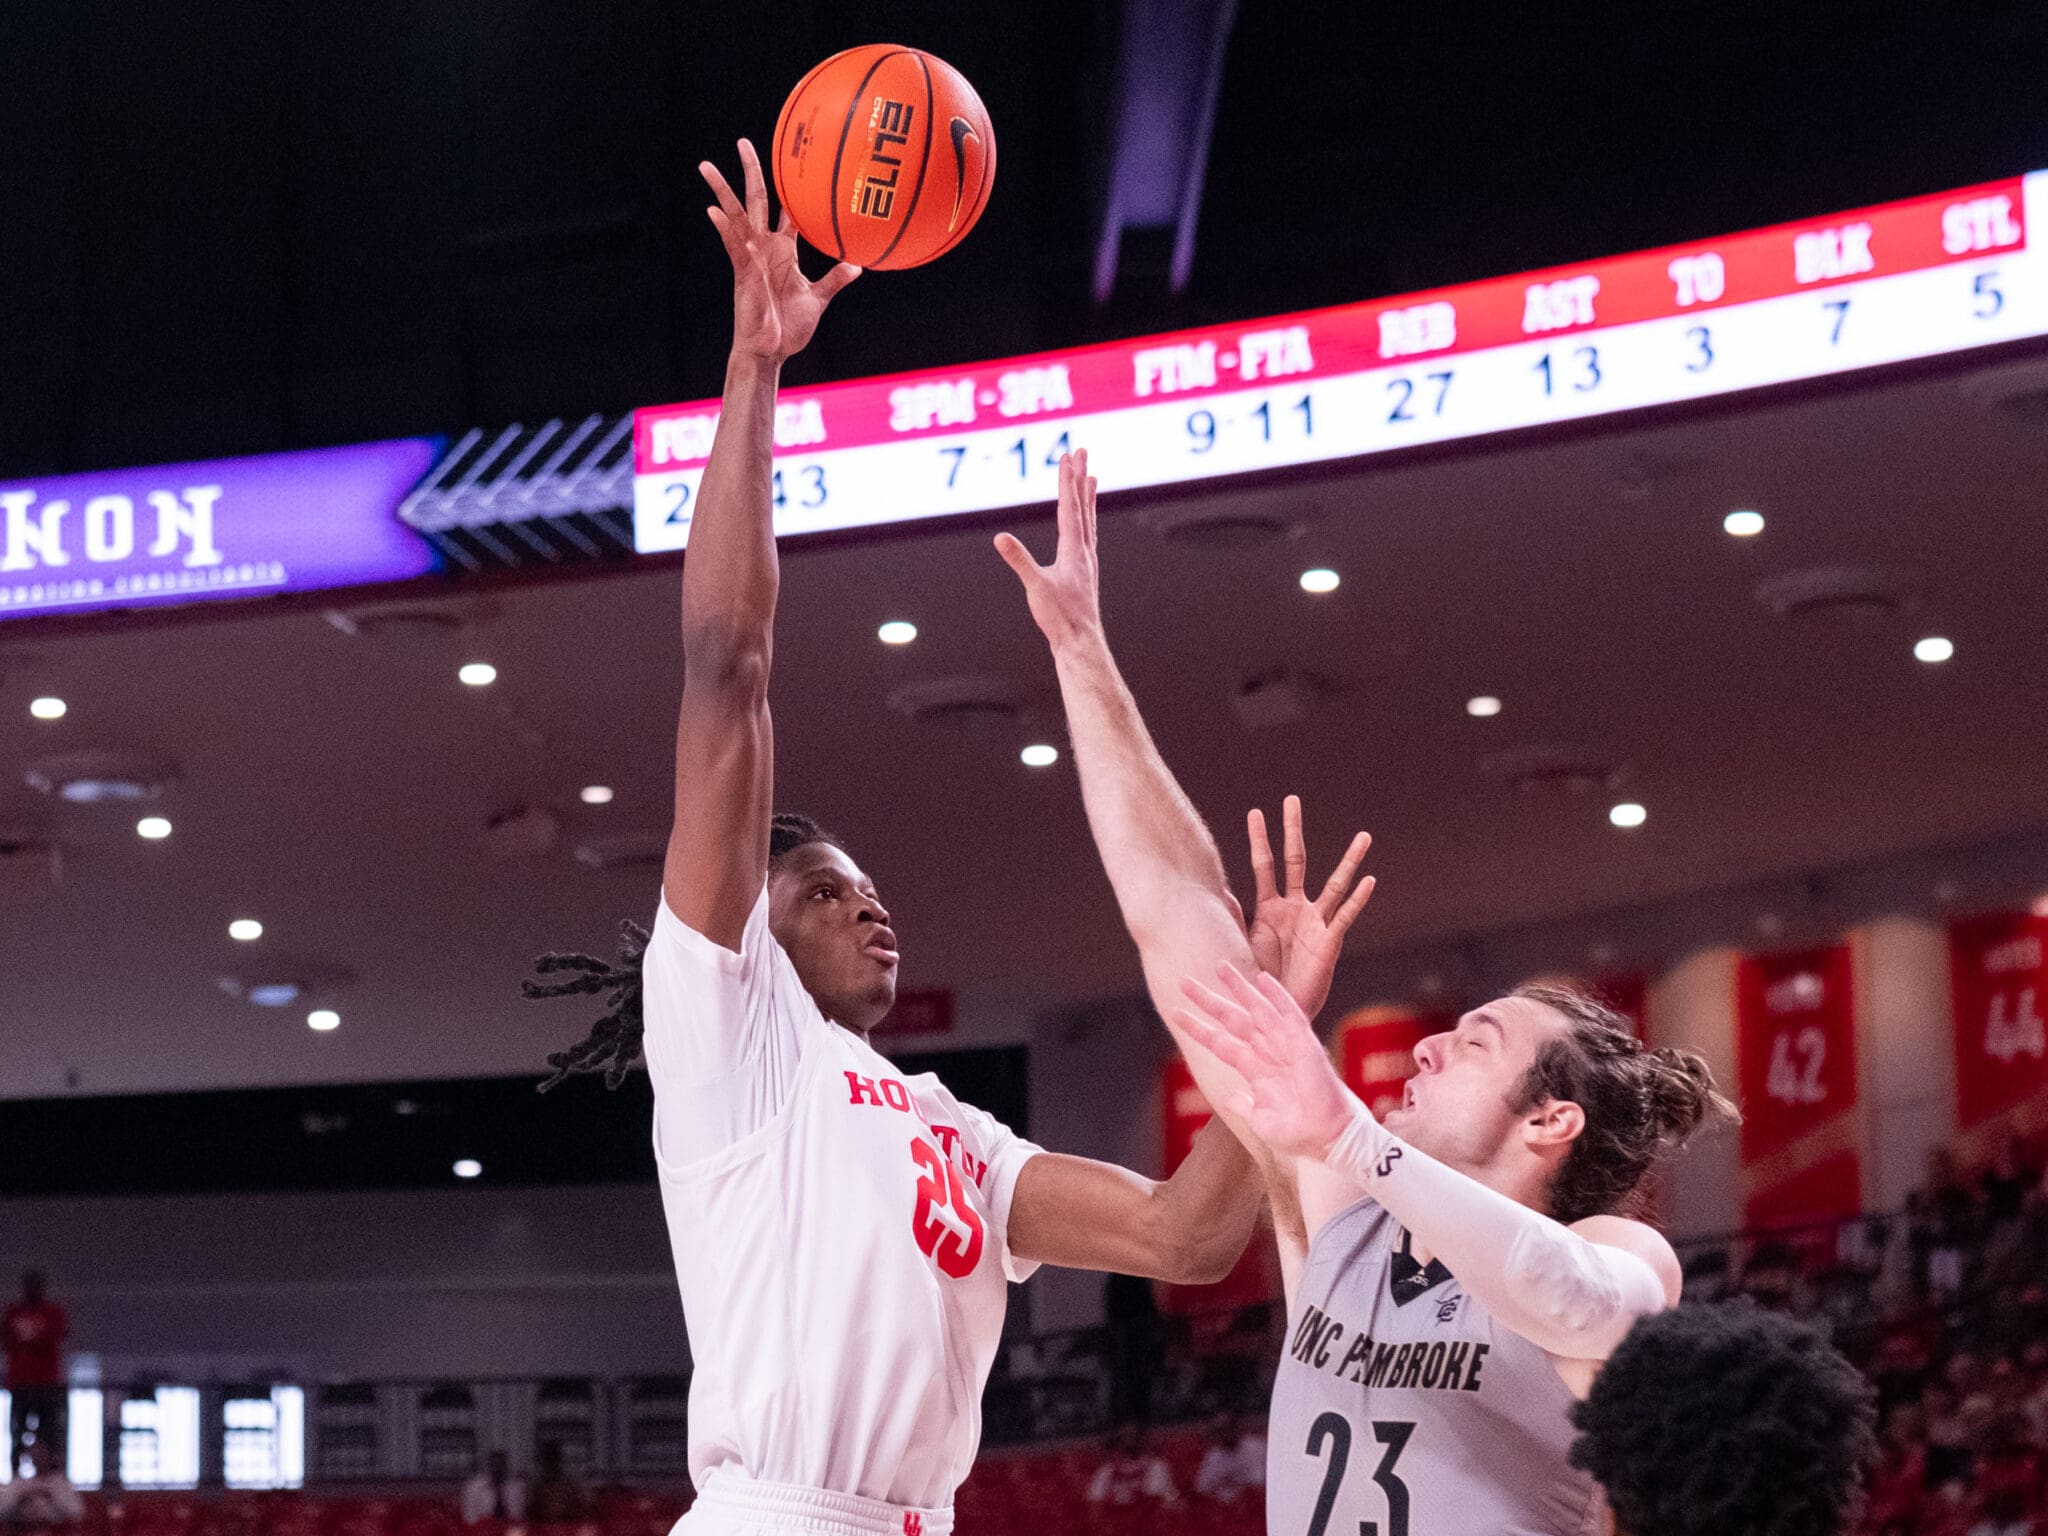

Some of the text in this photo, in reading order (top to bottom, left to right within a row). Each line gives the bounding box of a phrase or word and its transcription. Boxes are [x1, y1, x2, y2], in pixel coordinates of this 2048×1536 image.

[851, 97, 882, 213] CHANSHIP
[858, 99, 915, 220] ELITE
[1378, 302, 1456, 358] REB
[1523, 275, 1599, 332] AST
[1668, 252, 1724, 305] TO
[1793, 222, 1873, 283] BLK
[1942, 195, 2021, 255] STL
[1387, 371, 1454, 422] 27
[1531, 345, 1601, 395] 13
[1685, 327, 1715, 372] 3
[1822, 300, 1852, 346] 7
[1973, 270, 2002, 319] 5
[1767, 1026, 1828, 1102] 42
[1984, 986, 2045, 1062] 44
[910, 1136, 984, 1279] 25
[1290, 1304, 1344, 1369] UNC
[1305, 1411, 1417, 1536] 23
